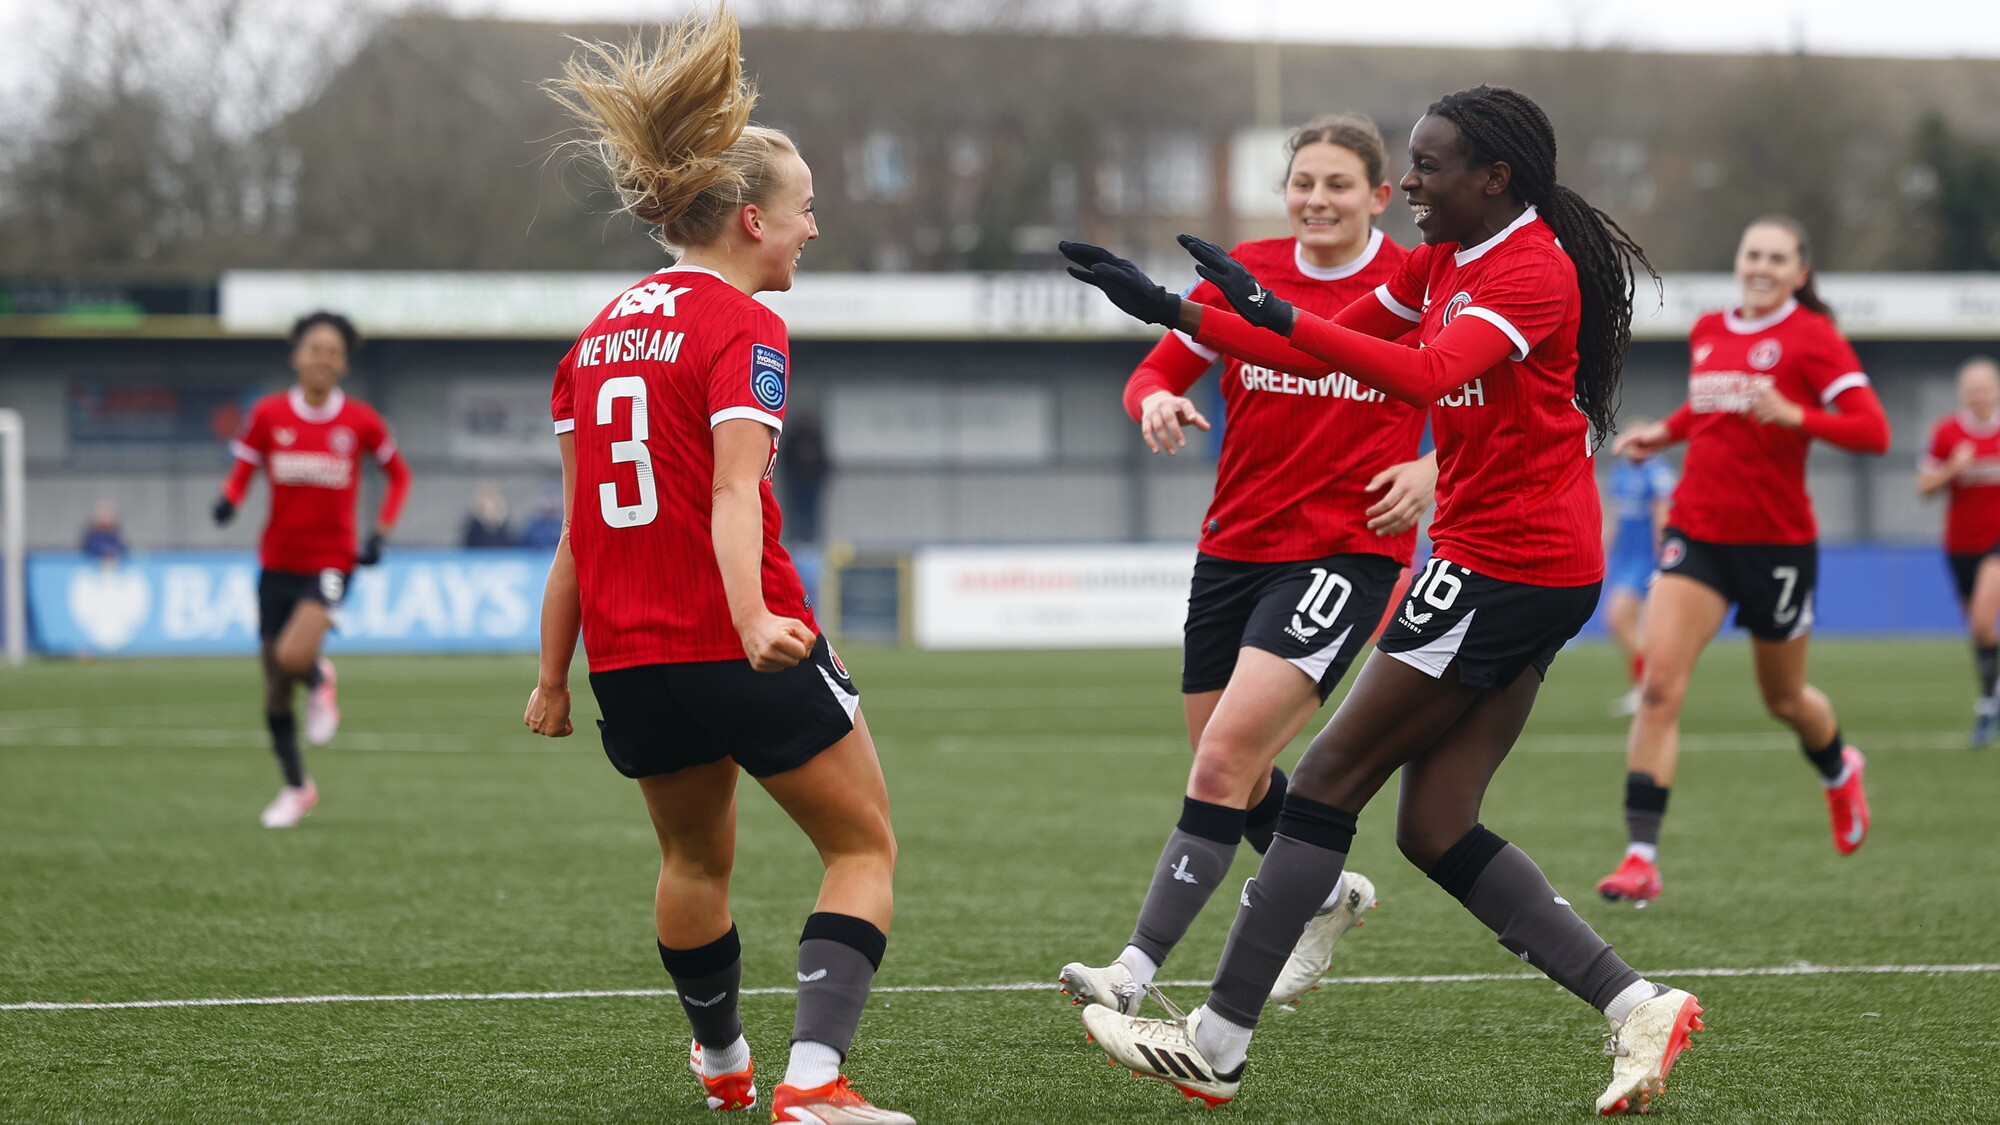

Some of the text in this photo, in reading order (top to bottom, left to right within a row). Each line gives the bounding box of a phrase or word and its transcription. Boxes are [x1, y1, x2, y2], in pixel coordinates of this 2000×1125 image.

[607, 281, 693, 319] RSK
[577, 328, 685, 368] NEWSHAM
[596, 375, 659, 529] 3
[162, 562, 532, 641] BALAYS
[1295, 567, 1353, 629] 10
[1410, 557, 1462, 611] 16
[1772, 566, 1799, 612] 7
